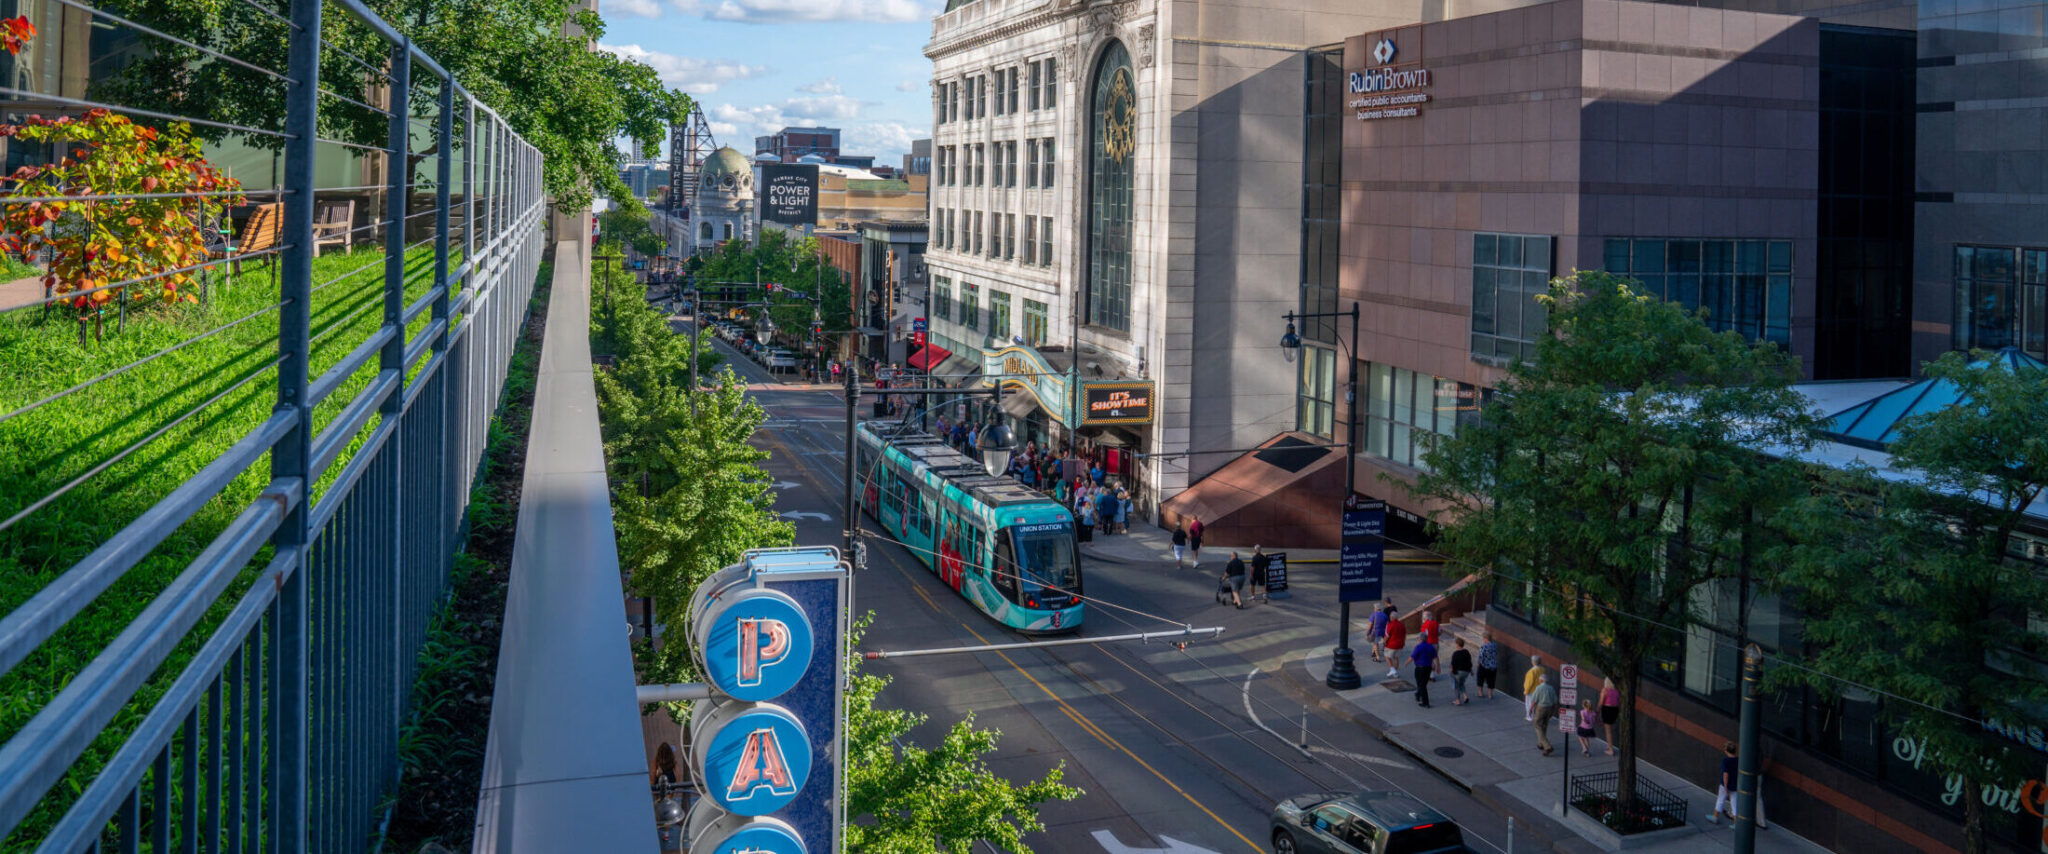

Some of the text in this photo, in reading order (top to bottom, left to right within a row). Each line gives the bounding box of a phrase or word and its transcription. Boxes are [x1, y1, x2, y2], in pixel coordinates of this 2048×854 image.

[1349, 68, 1427, 94] RubinBrown
[1349, 94, 1427, 108] certified public accountants
[1357, 107, 1417, 120] business consultants
[770, 185, 810, 196] POWER
[770, 195, 809, 206] & LIGHT
[1004, 357, 1039, 387] MIDLAND
[1109, 391, 1131, 401] IT'S
[1090, 398, 1148, 411] SHOWTIME
[1020, 525, 1038, 533] UNION
